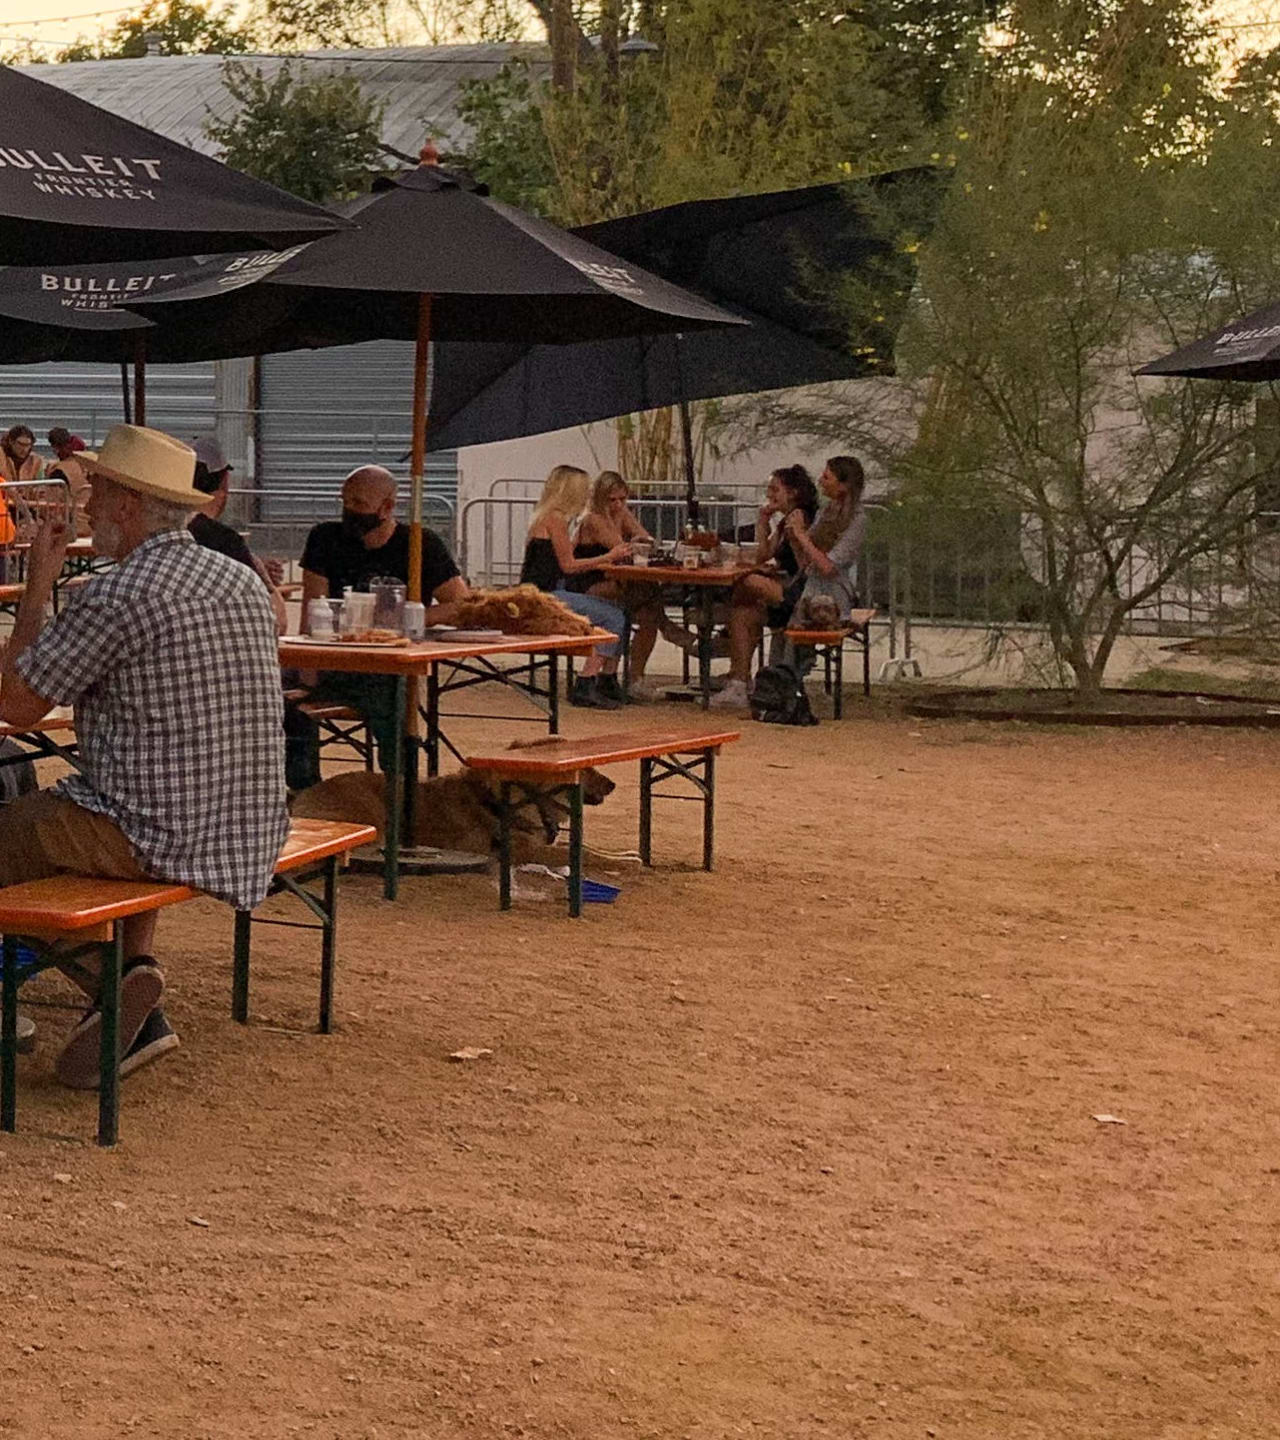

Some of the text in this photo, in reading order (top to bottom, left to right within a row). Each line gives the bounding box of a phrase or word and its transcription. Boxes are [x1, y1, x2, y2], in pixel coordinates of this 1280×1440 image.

[34, 172, 132, 187] FRONTIER
[33, 180, 156, 200] WHISKEY
[61, 299, 110, 308] WHIS
